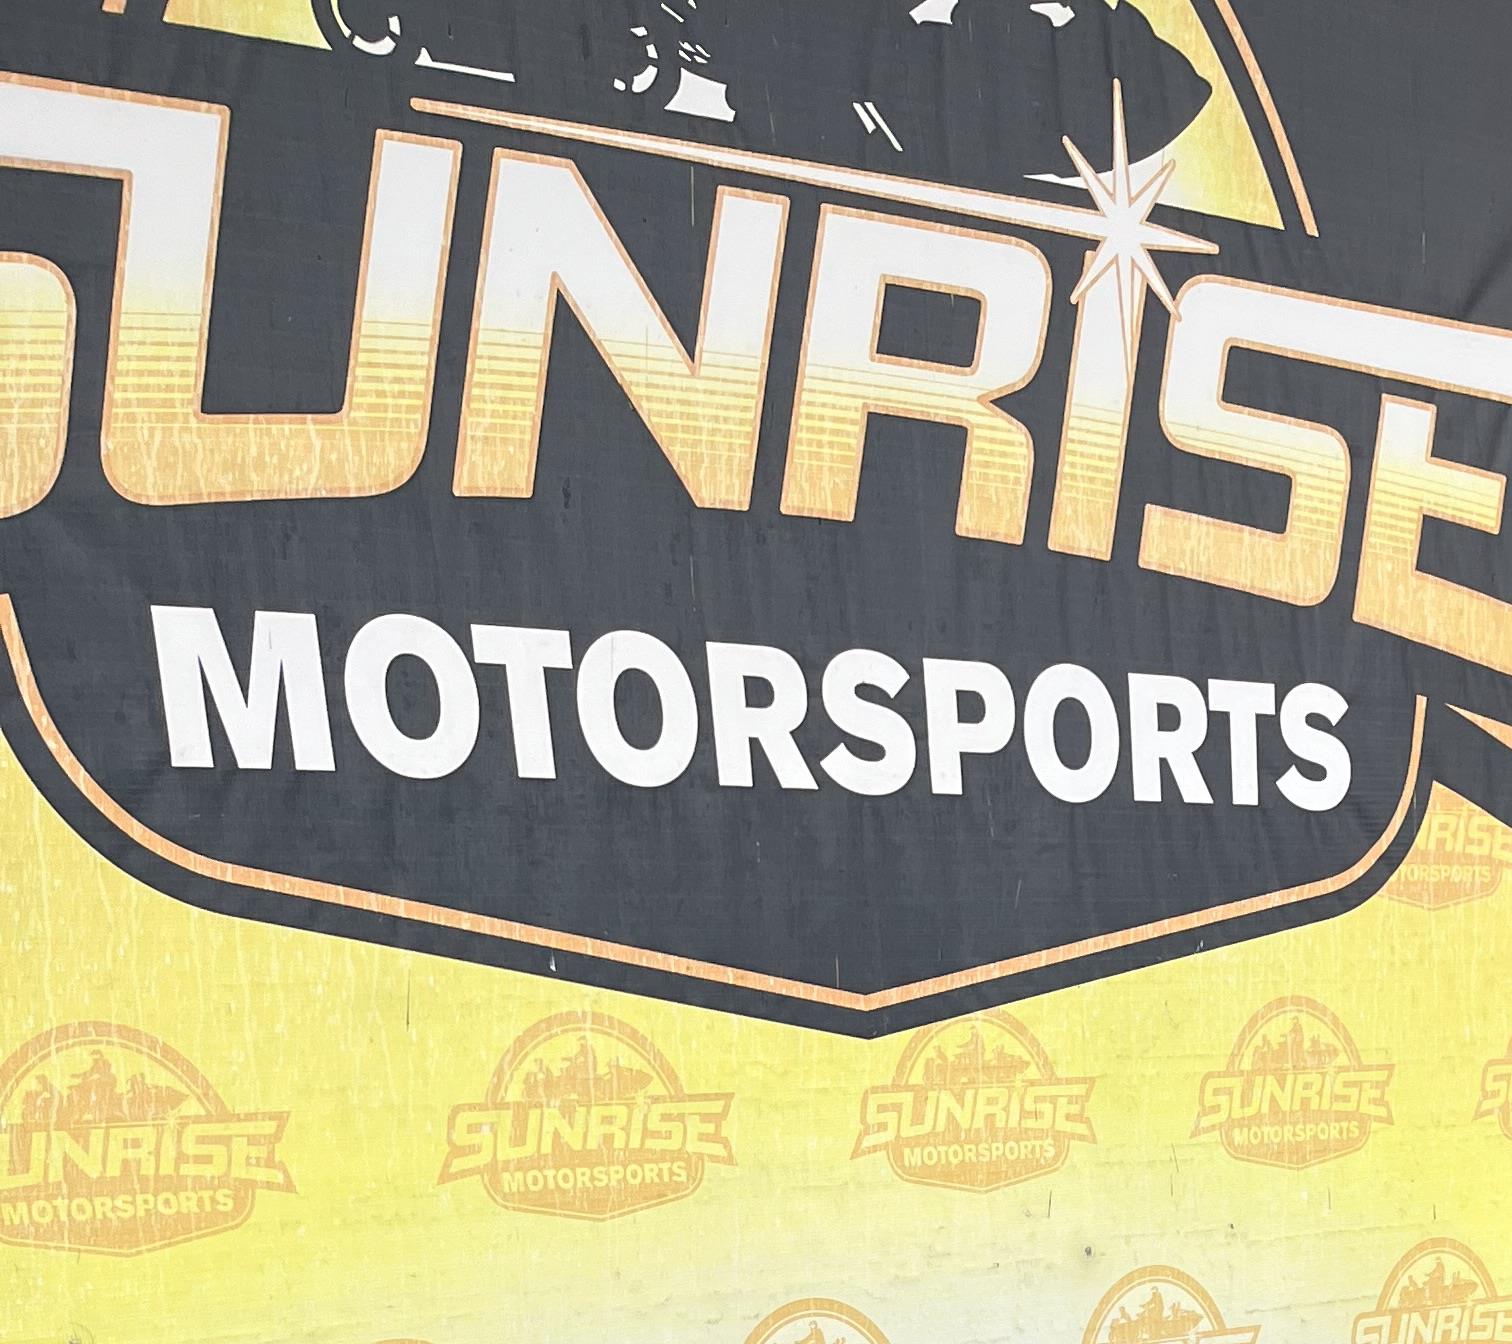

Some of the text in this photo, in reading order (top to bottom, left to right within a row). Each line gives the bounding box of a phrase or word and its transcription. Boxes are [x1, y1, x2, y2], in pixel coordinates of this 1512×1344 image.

[151, 604, 1352, 812] MOTORSPORTS
[862, 1084, 1093, 1147] SUNRISE
[1200, 1068, 1393, 1124] SUNRISE
[447, 1098, 729, 1172] SUNRISE
[903, 1139, 1055, 1168] MOTORSPORTS
[1232, 1120, 1360, 1147] MOTORSPORTS
[501, 1161, 687, 1193] MOTORSPORTS
[2, 1188, 234, 1226] MOTORSPORTS
